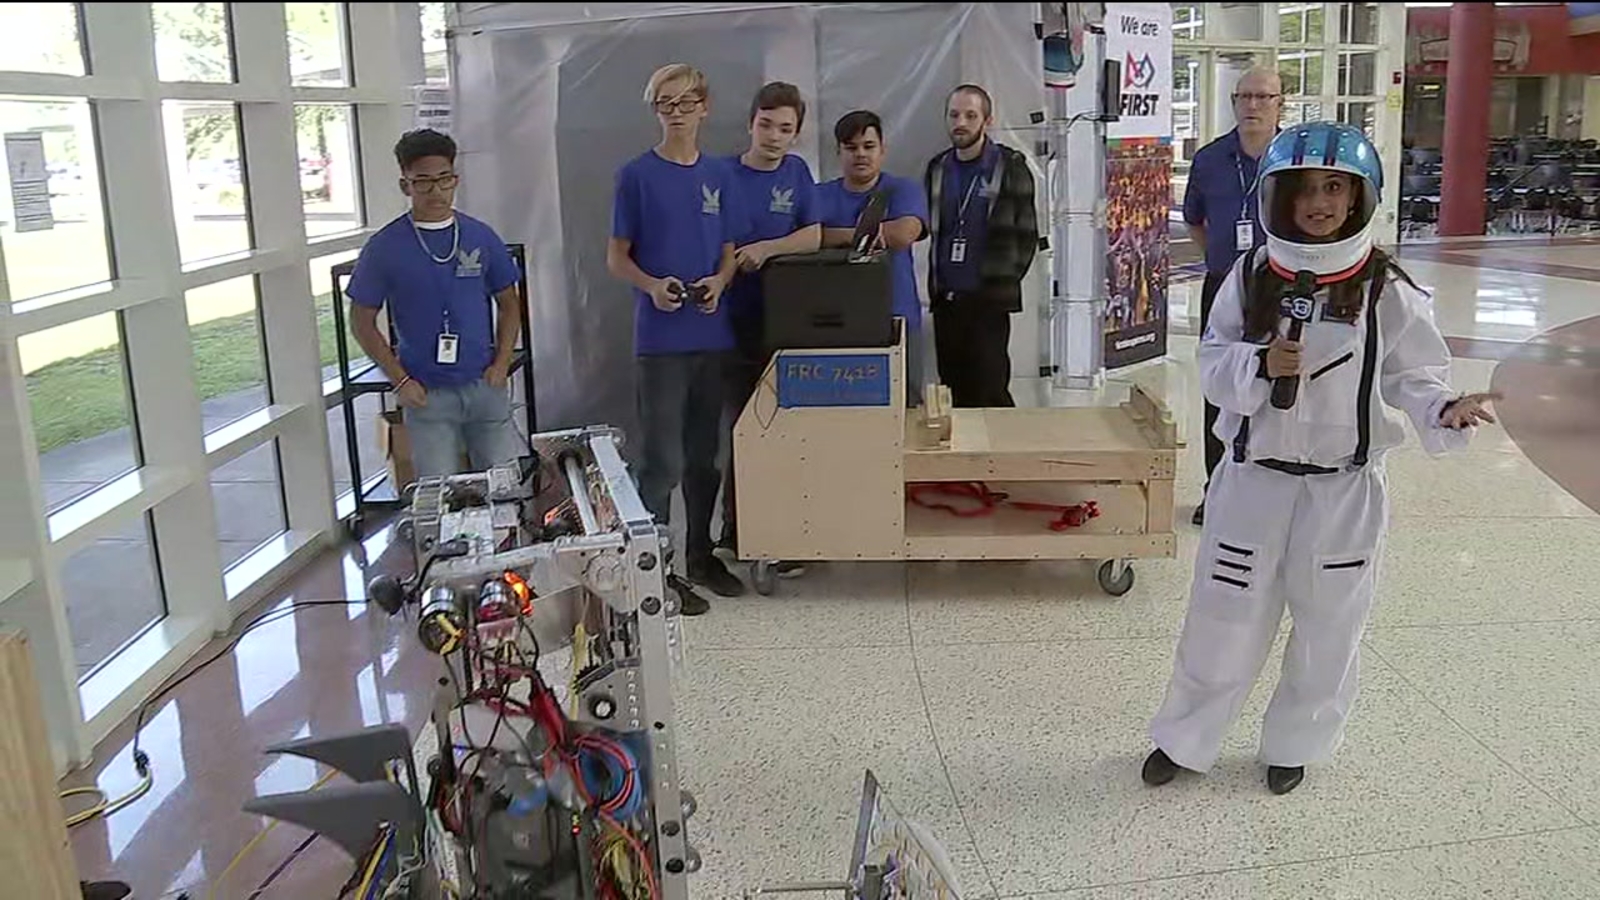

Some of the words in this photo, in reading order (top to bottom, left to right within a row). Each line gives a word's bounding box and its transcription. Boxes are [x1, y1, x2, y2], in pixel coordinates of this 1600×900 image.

[1120, 15, 1138, 35] We
[1140, 21, 1160, 37] are
[1119, 93, 1160, 117] FIRST
[787, 363, 825, 381] FRC
